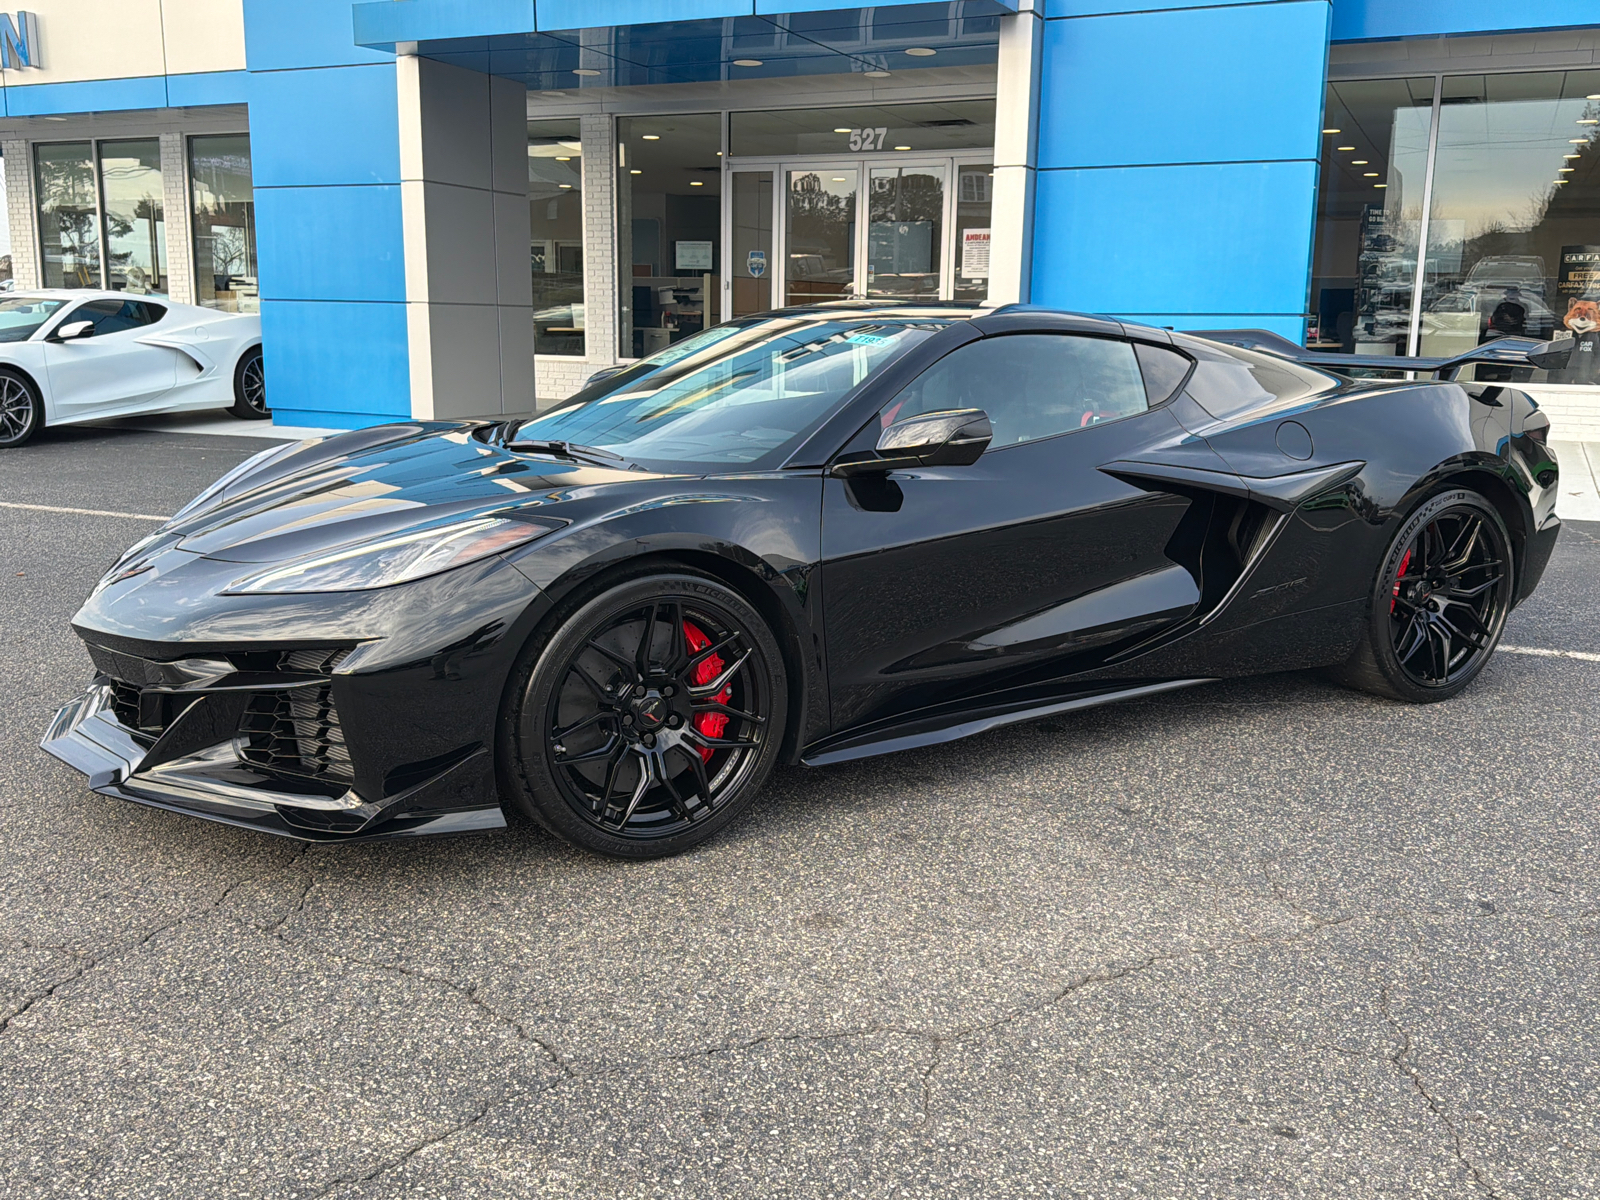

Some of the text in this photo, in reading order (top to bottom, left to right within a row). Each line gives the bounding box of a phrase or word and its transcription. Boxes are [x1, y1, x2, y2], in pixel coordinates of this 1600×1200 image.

[849, 127, 888, 151] 527
[1392, 516, 1420, 562] MICHELIN
[695, 585, 748, 616] MICHELIN
[710, 749, 740, 790] CORVETTE
